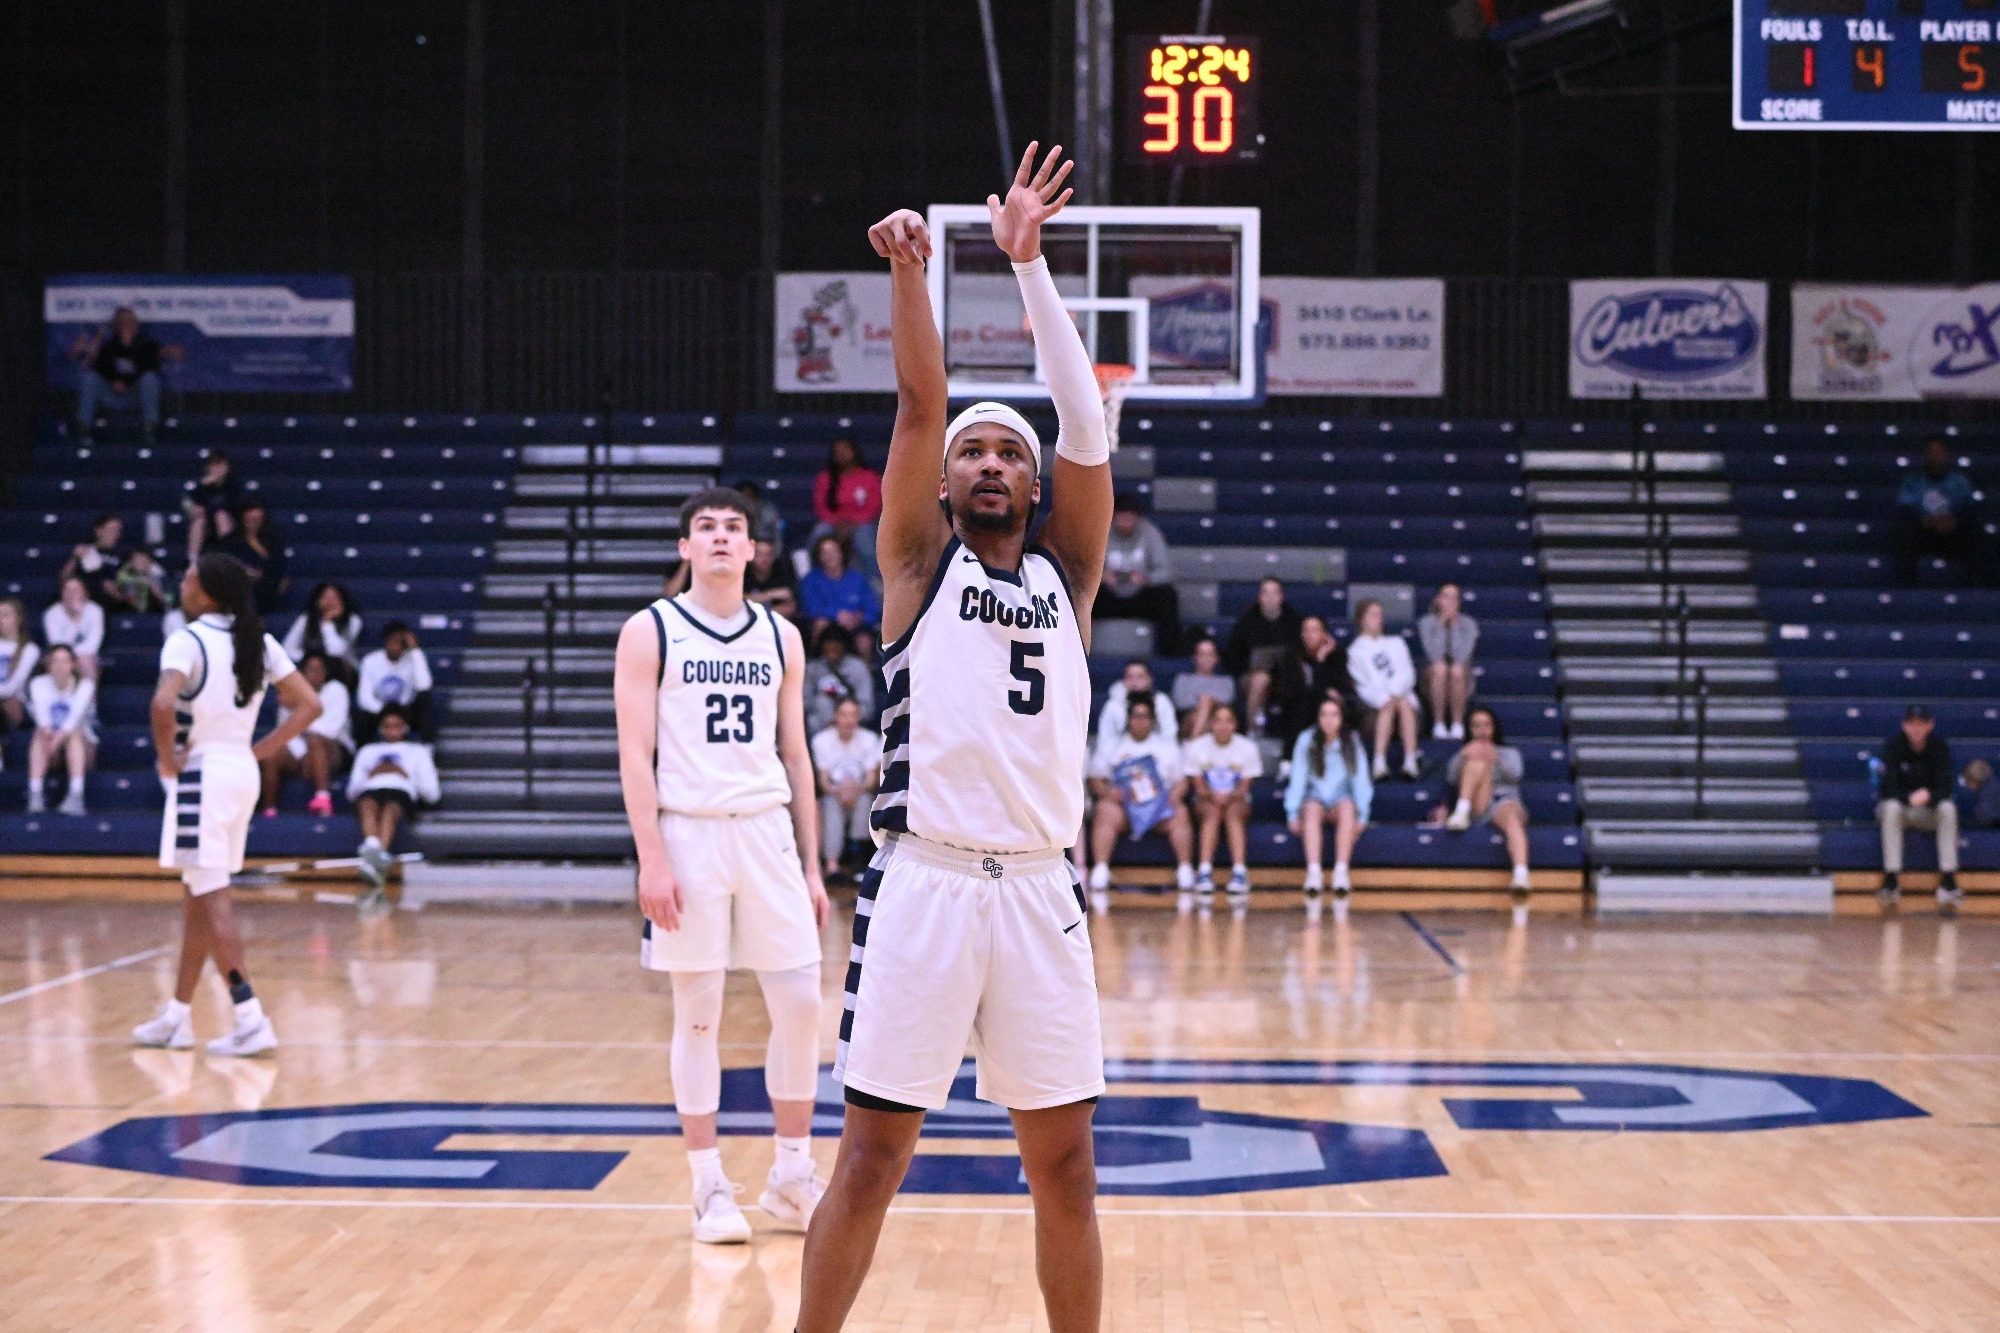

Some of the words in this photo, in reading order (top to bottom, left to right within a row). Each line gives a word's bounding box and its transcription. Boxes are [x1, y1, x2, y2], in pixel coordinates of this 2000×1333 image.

[1761, 19, 1822, 41] FOULS
[1846, 19, 1895, 41] T.O.L.
[1920, 20, 1990, 41] PLAYER
[1151, 45, 1249, 85] 12:24
[1804, 48, 1814, 87] 1
[1856, 48, 1885, 88] 4
[1958, 45, 1985, 91] 5
[1144, 86, 1232, 152] 30
[1760, 99, 1823, 120] SCORE
[1946, 100, 2000, 121] MATC
[959, 586, 1058, 629] COUGARS
[683, 660, 771, 686] COUGARS
[1008, 640, 1046, 715] 5
[705, 693, 753, 743] 23
